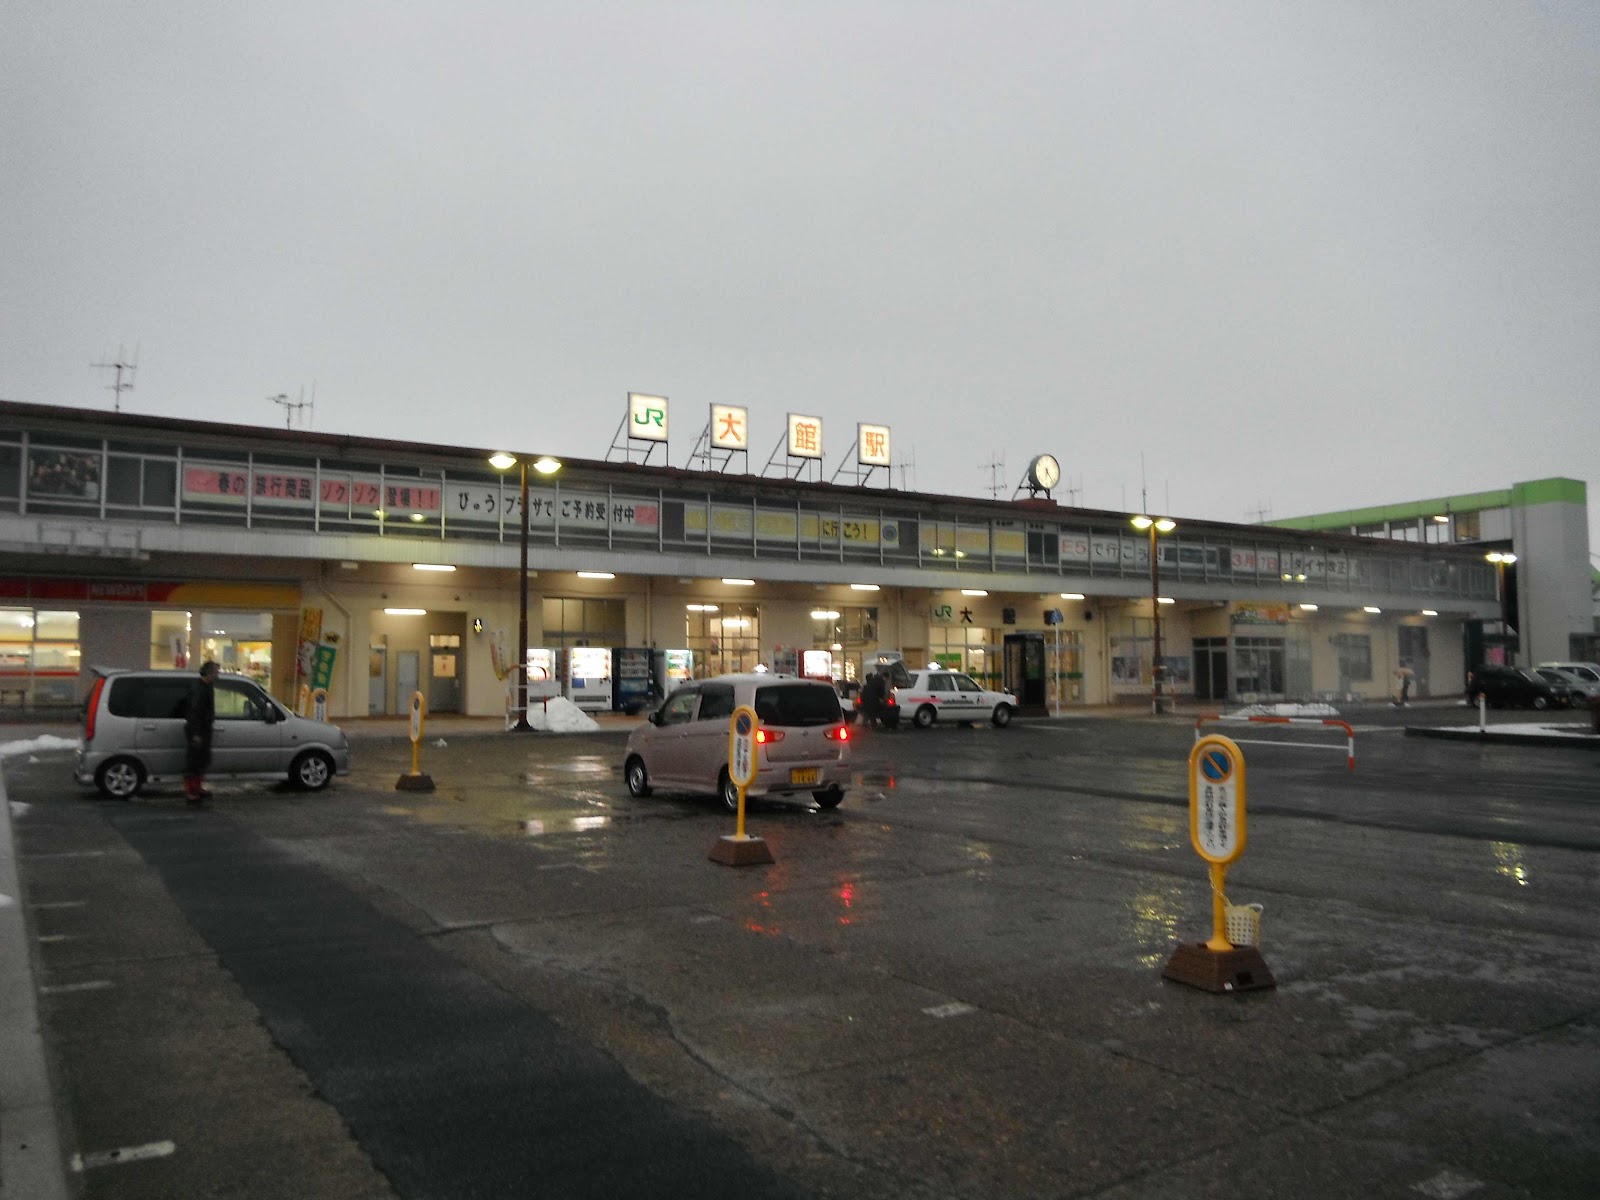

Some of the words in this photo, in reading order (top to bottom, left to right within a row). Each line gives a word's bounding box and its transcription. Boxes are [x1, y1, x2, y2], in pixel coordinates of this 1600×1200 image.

[634, 407, 664, 427] JR
[718, 412, 742, 442] 大
[794, 421, 817, 451] 館
[934, 605, 953, 619] JR
